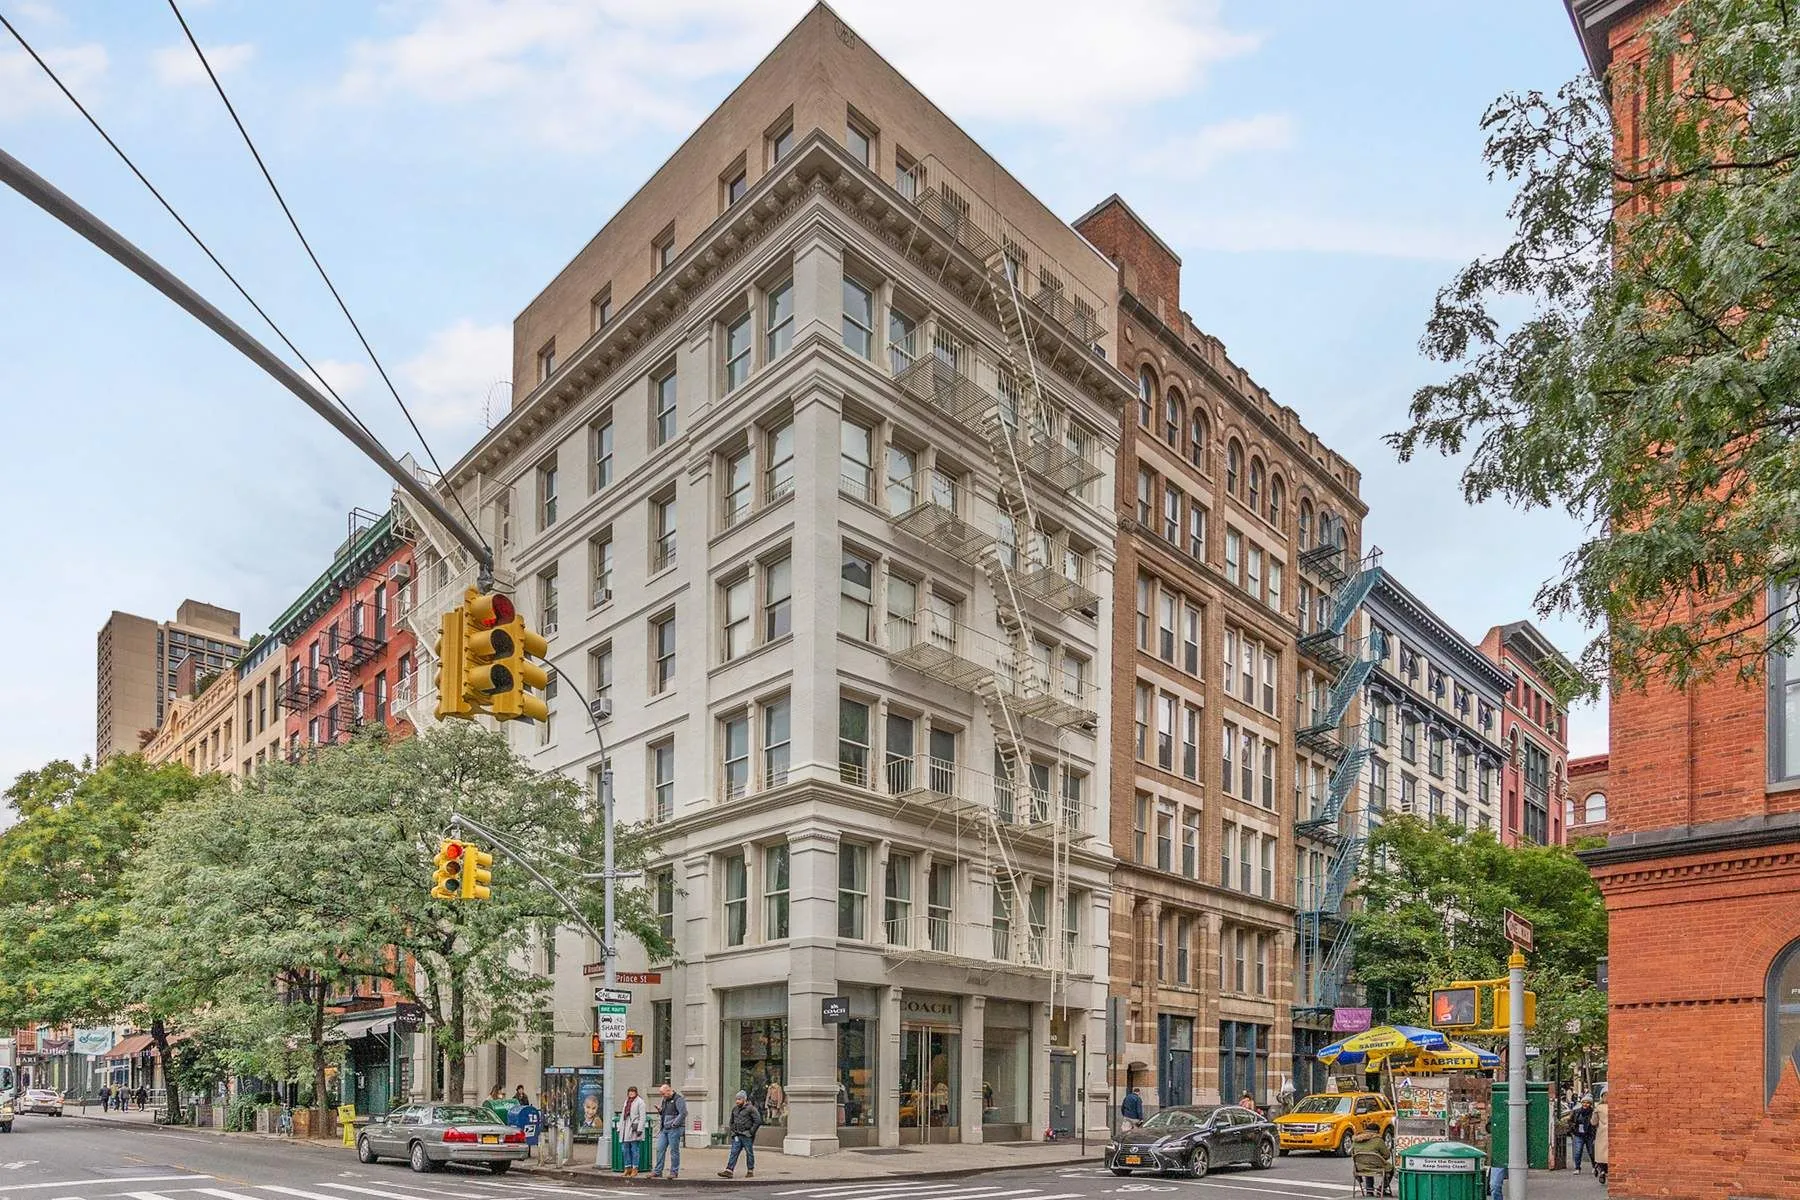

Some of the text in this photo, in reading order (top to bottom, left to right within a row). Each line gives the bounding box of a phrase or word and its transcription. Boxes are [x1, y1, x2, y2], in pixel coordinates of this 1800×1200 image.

[616, 974, 647, 983] Prince St
[598, 991, 610, 999] ONE
[900, 1000, 952, 1014] COACH
[1360, 1041, 1396, 1050] SABRETT
[1423, 1057, 1474, 1066] SABRETT
